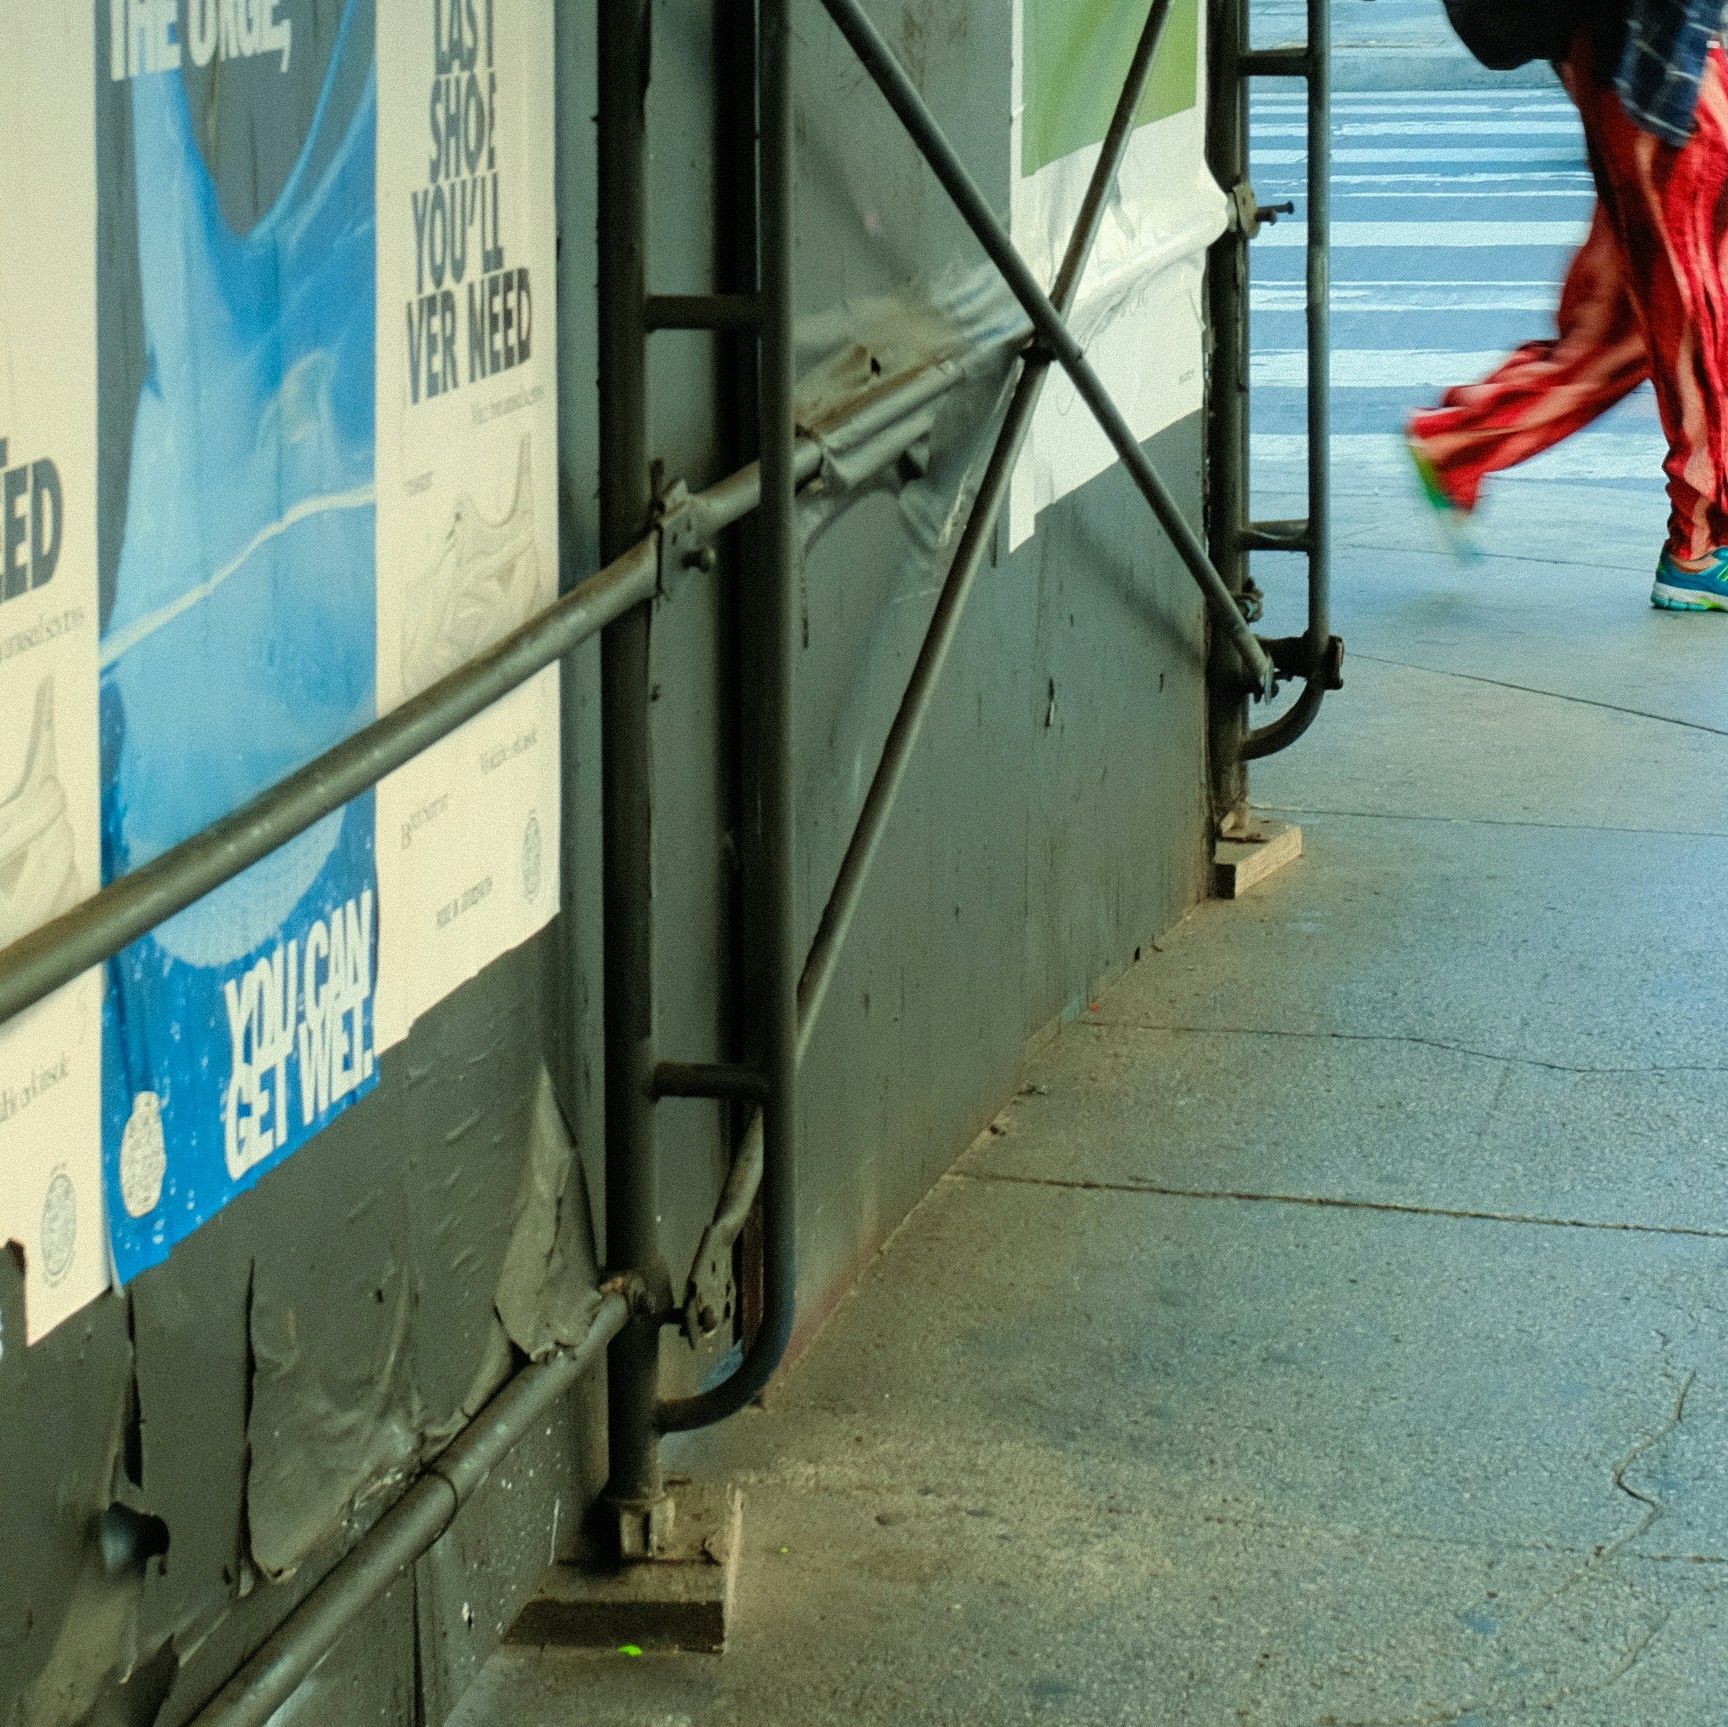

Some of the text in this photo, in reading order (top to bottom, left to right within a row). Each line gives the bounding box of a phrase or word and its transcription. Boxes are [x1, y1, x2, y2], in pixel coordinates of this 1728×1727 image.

[410, 171, 504, 296] YOU'LL
[468, 266, 532, 384] NEED
[224, 938, 298, 1074] YOU
[304, 889, 373, 1024] CAN
[224, 1003, 374, 1182] GET WET.
